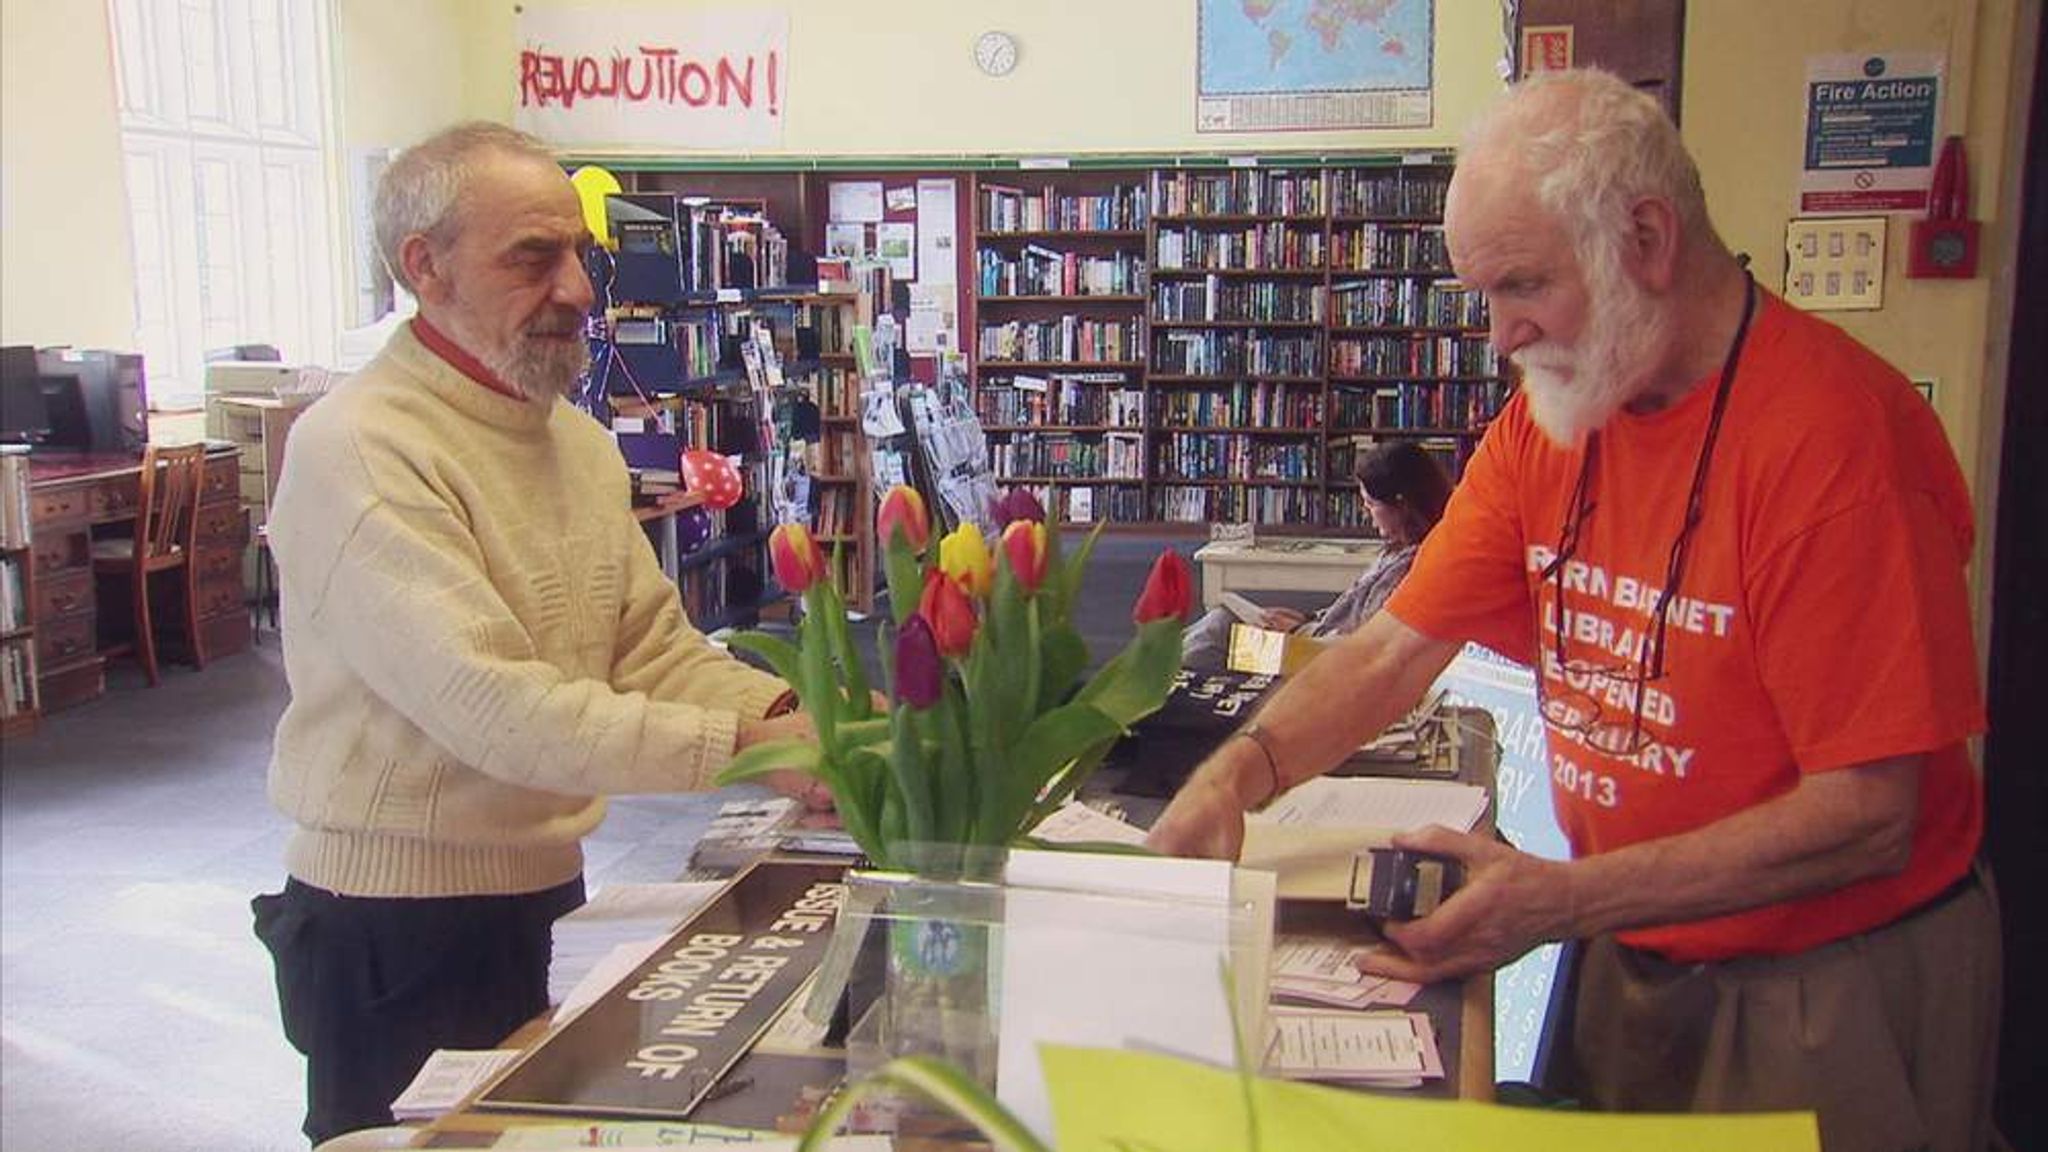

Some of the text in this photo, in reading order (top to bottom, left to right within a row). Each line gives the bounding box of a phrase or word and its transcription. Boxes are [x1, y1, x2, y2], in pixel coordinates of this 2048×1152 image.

[1816, 82, 1930, 101] Fire Action
[1553, 753, 1617, 807] 2013
[770, 884, 847, 933] ISSUE
[752, 935, 804, 949] &
[628, 935, 742, 1001] BOOKS
[662, 955, 788, 1037] RETURN
[626, 1045, 699, 1080] OF
